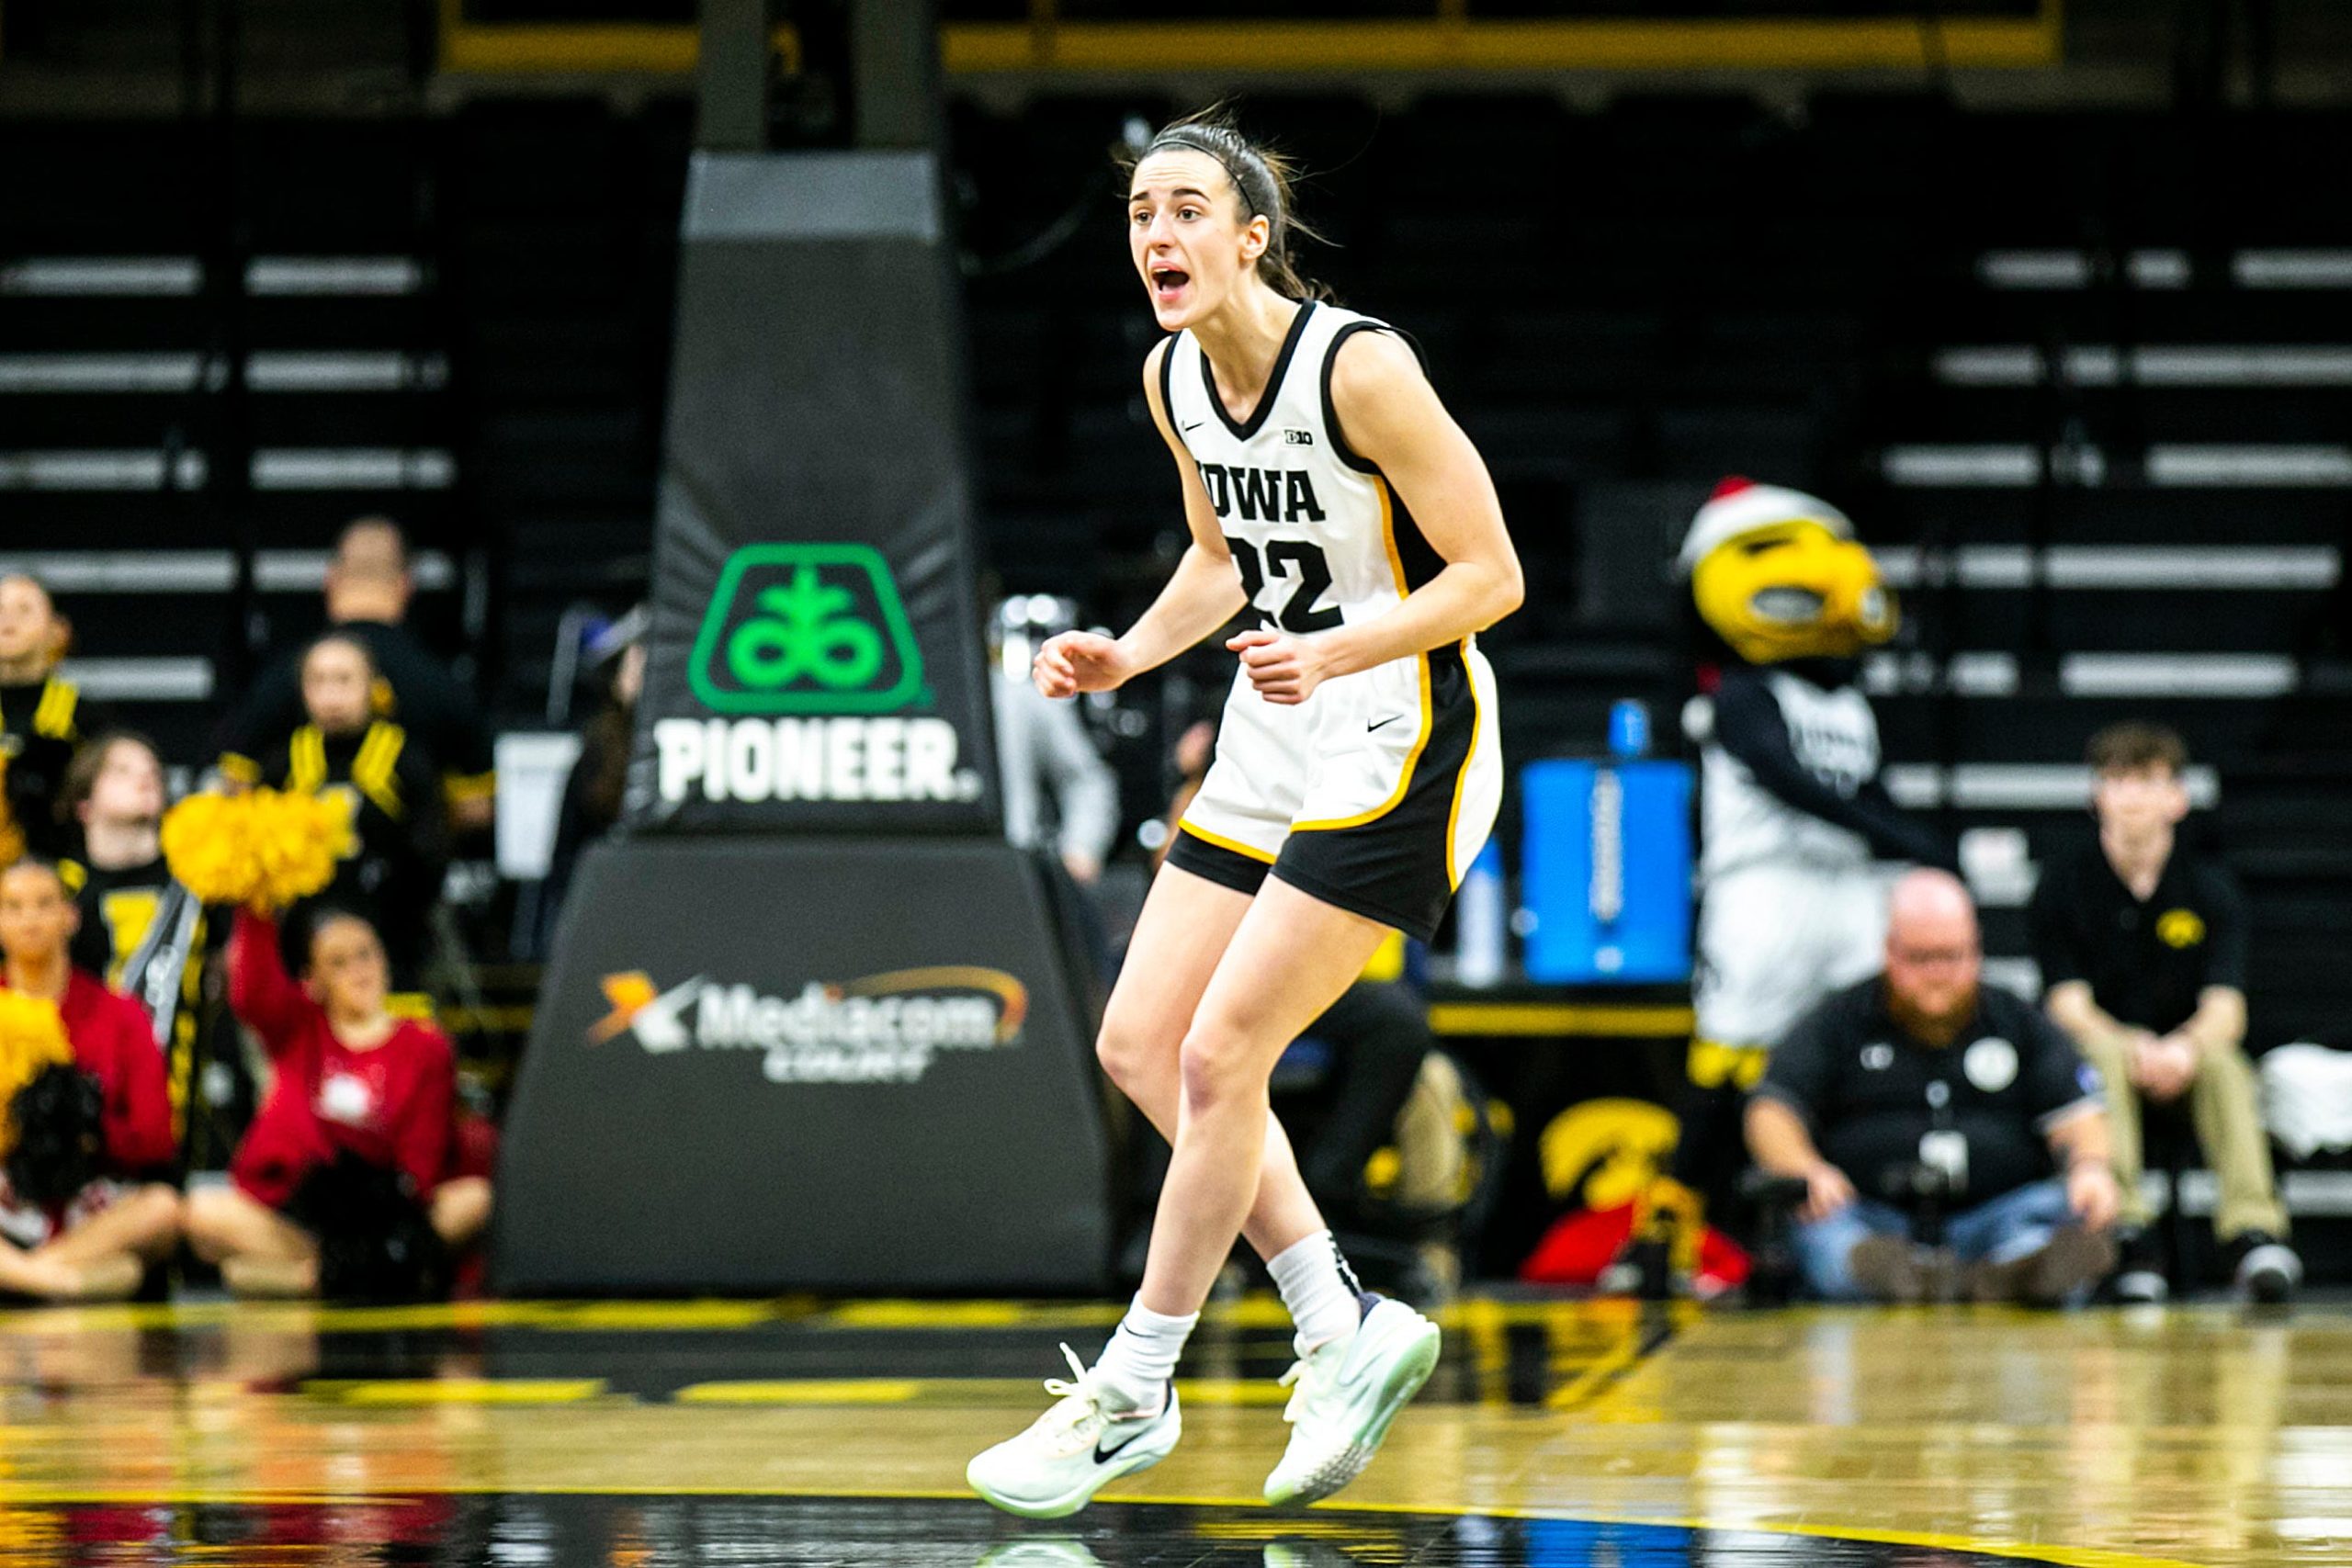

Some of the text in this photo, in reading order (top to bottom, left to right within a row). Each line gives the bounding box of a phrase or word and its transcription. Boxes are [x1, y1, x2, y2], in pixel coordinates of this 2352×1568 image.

[1195, 460, 1326, 523] OWA
[655, 717, 958, 802] PIONEER
[697, 983, 997, 1049] Mediacom
